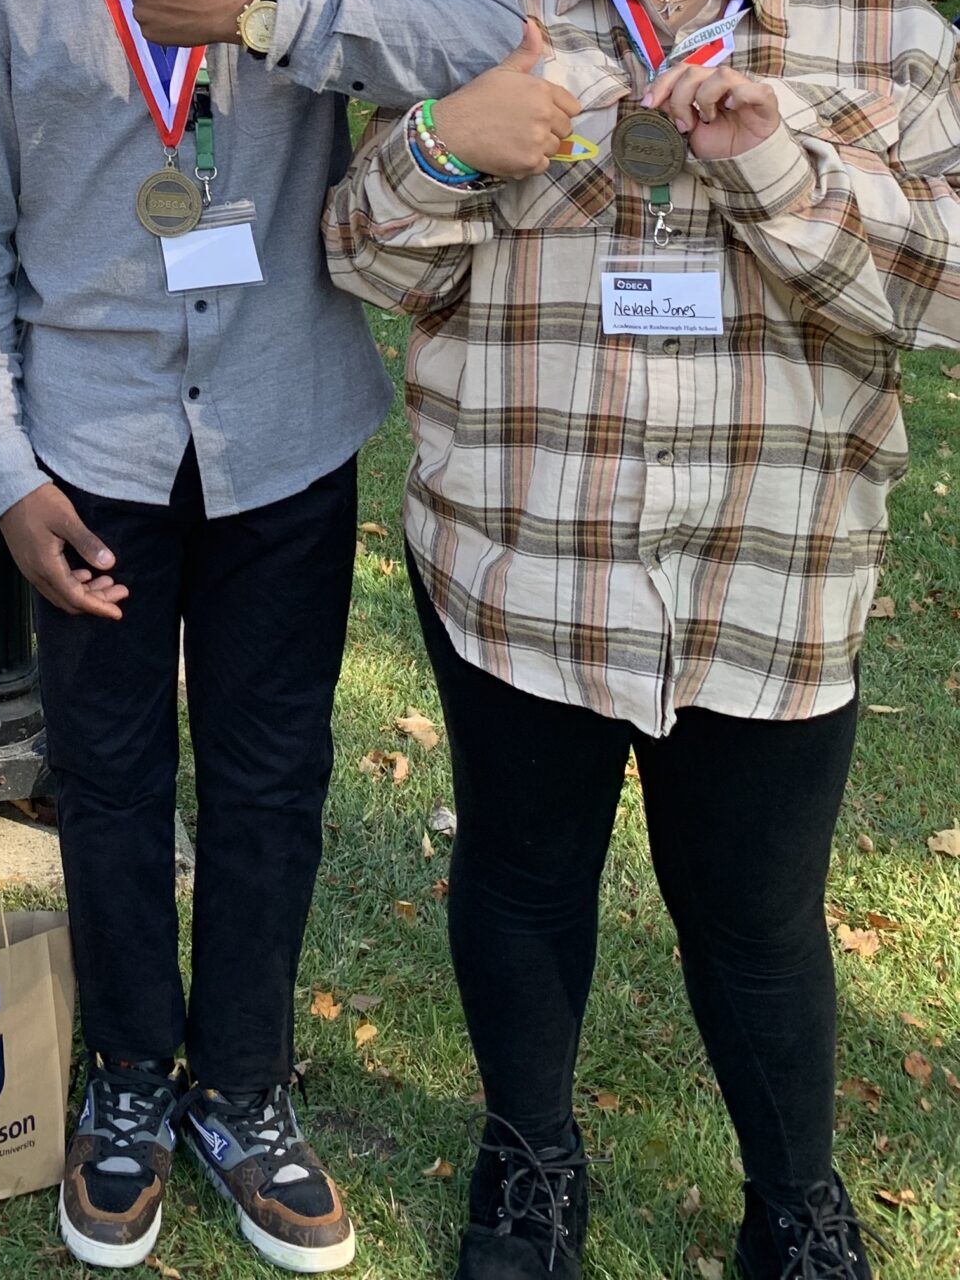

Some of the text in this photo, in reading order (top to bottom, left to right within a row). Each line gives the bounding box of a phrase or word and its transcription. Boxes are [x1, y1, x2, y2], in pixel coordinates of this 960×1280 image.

[157, 199, 187, 210] DECA
[625, 282, 649, 290] DECA
[614, 296, 696, 318] Nevaeh Jones
[0, 1140, 35, 1157] University
